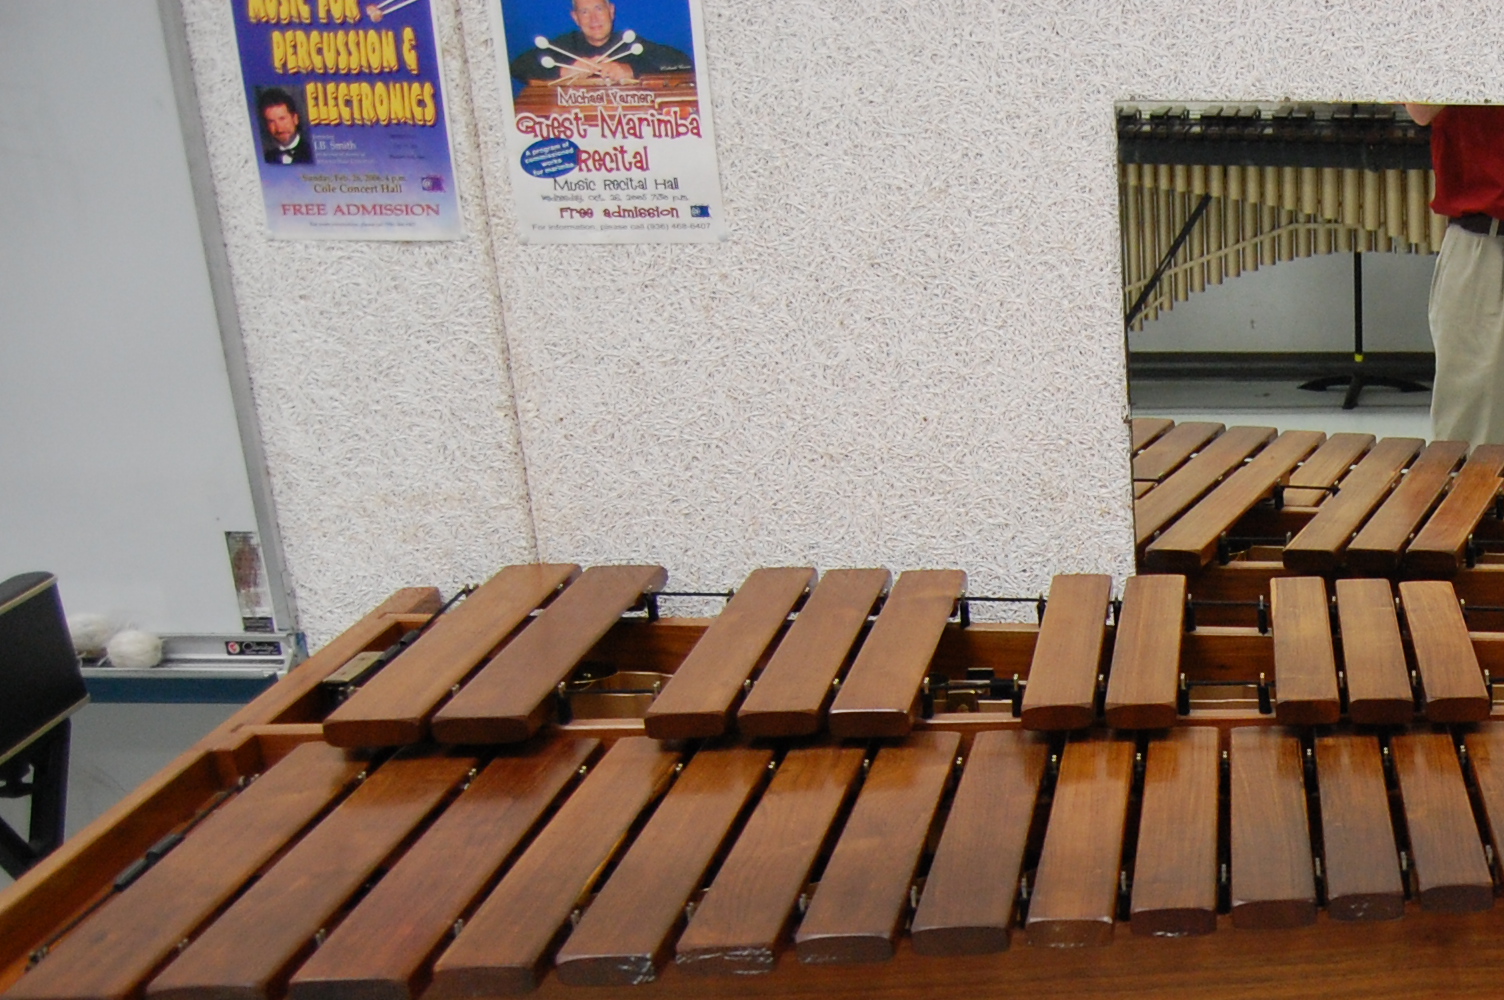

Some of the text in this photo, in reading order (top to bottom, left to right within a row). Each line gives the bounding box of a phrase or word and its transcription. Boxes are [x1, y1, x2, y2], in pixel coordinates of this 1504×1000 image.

[271, 26, 419, 74] PERCUSSION &
[305, 81, 437, 126] ELECTRONICS
[557, 86, 655, 106] Michael Varner
[516, 107, 702, 140] Guest Marimba
[329, 140, 357, 150] Smith
[577, 145, 650, 172] Recital
[313, 183, 403, 194] Cole Concert Hall
[553, 177, 680, 191] Music Recital Hall
[281, 203, 441, 216] FREE ADMISSION
[559, 205, 680, 219] Free admission
